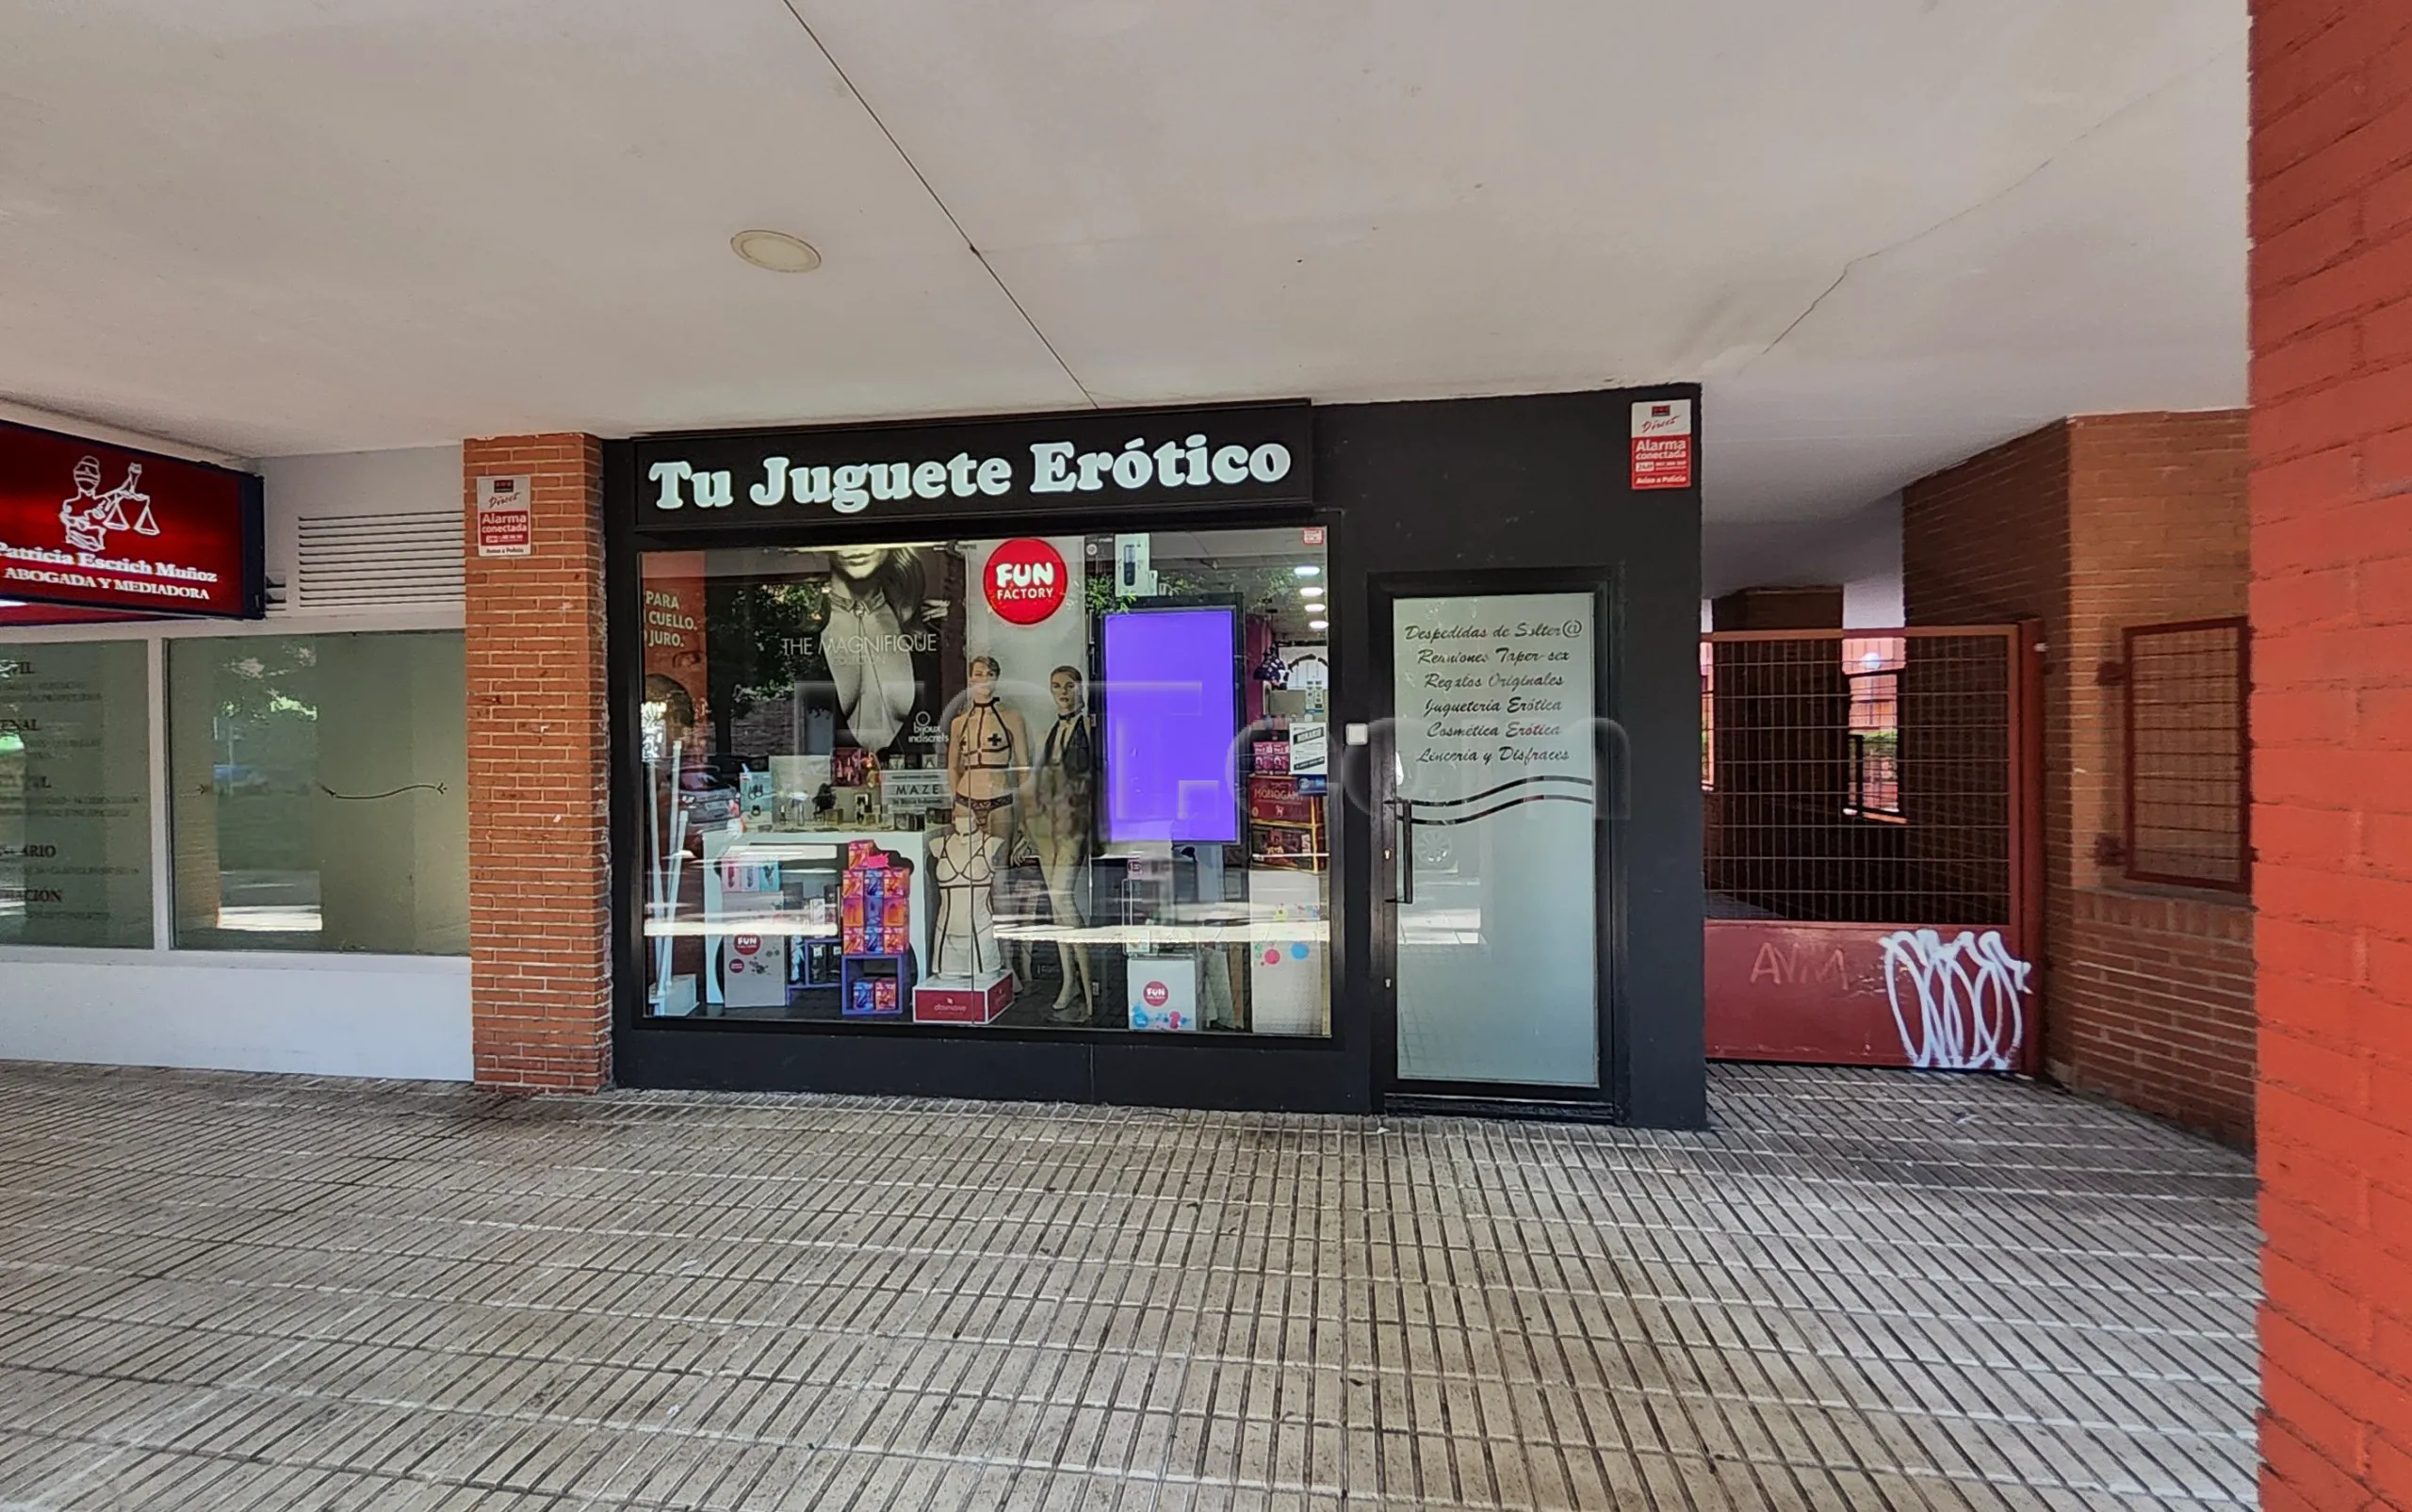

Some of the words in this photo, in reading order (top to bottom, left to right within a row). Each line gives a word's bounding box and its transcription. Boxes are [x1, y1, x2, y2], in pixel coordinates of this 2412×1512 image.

[1636, 439, 1687, 451] Alarma
[1636, 449, 1687, 460] conectada
[648, 461, 733, 511] Tu
[749, 453, 1013, 514] Juguete
[1029, 434, 1292, 497] Erótico
[481, 513, 527, 525] Alarma
[481, 524, 528, 533] conectada
[0, 542, 74, 565] Patricia
[155, 561, 218, 583] Muñoz
[4, 567, 97, 589] ABOGADA
[97, 577, 115, 590] Y
[114, 578, 210, 600] MEDIADORA
[996, 561, 1054, 589] FUN
[645, 590, 680, 610] PARA
[997, 587, 1053, 600] FACTORY
[648, 610, 698, 631] CUELLO.
[648, 629, 685, 647] JURO.
[1404, 626, 1489, 644] Despedidas
[1492, 625, 1511, 639] de
[781, 637, 813, 656] THE
[817, 633, 937, 655] MAGNIFIQUE
[1488, 672, 1565, 692] Originales
[1424, 698, 1502, 718] Juguetería
[1507, 696, 1563, 714] Erótica
[1426, 722, 1501, 738] Cosmética
[1505, 722, 1562, 738] Erótica
[1483, 752, 1493, 766] y
[1498, 745, 1570, 766] Disfraces
[896, 784, 940, 796] MAZE
[737, 936, 758, 946] FUN
[1146, 987, 1165, 997] FUN
